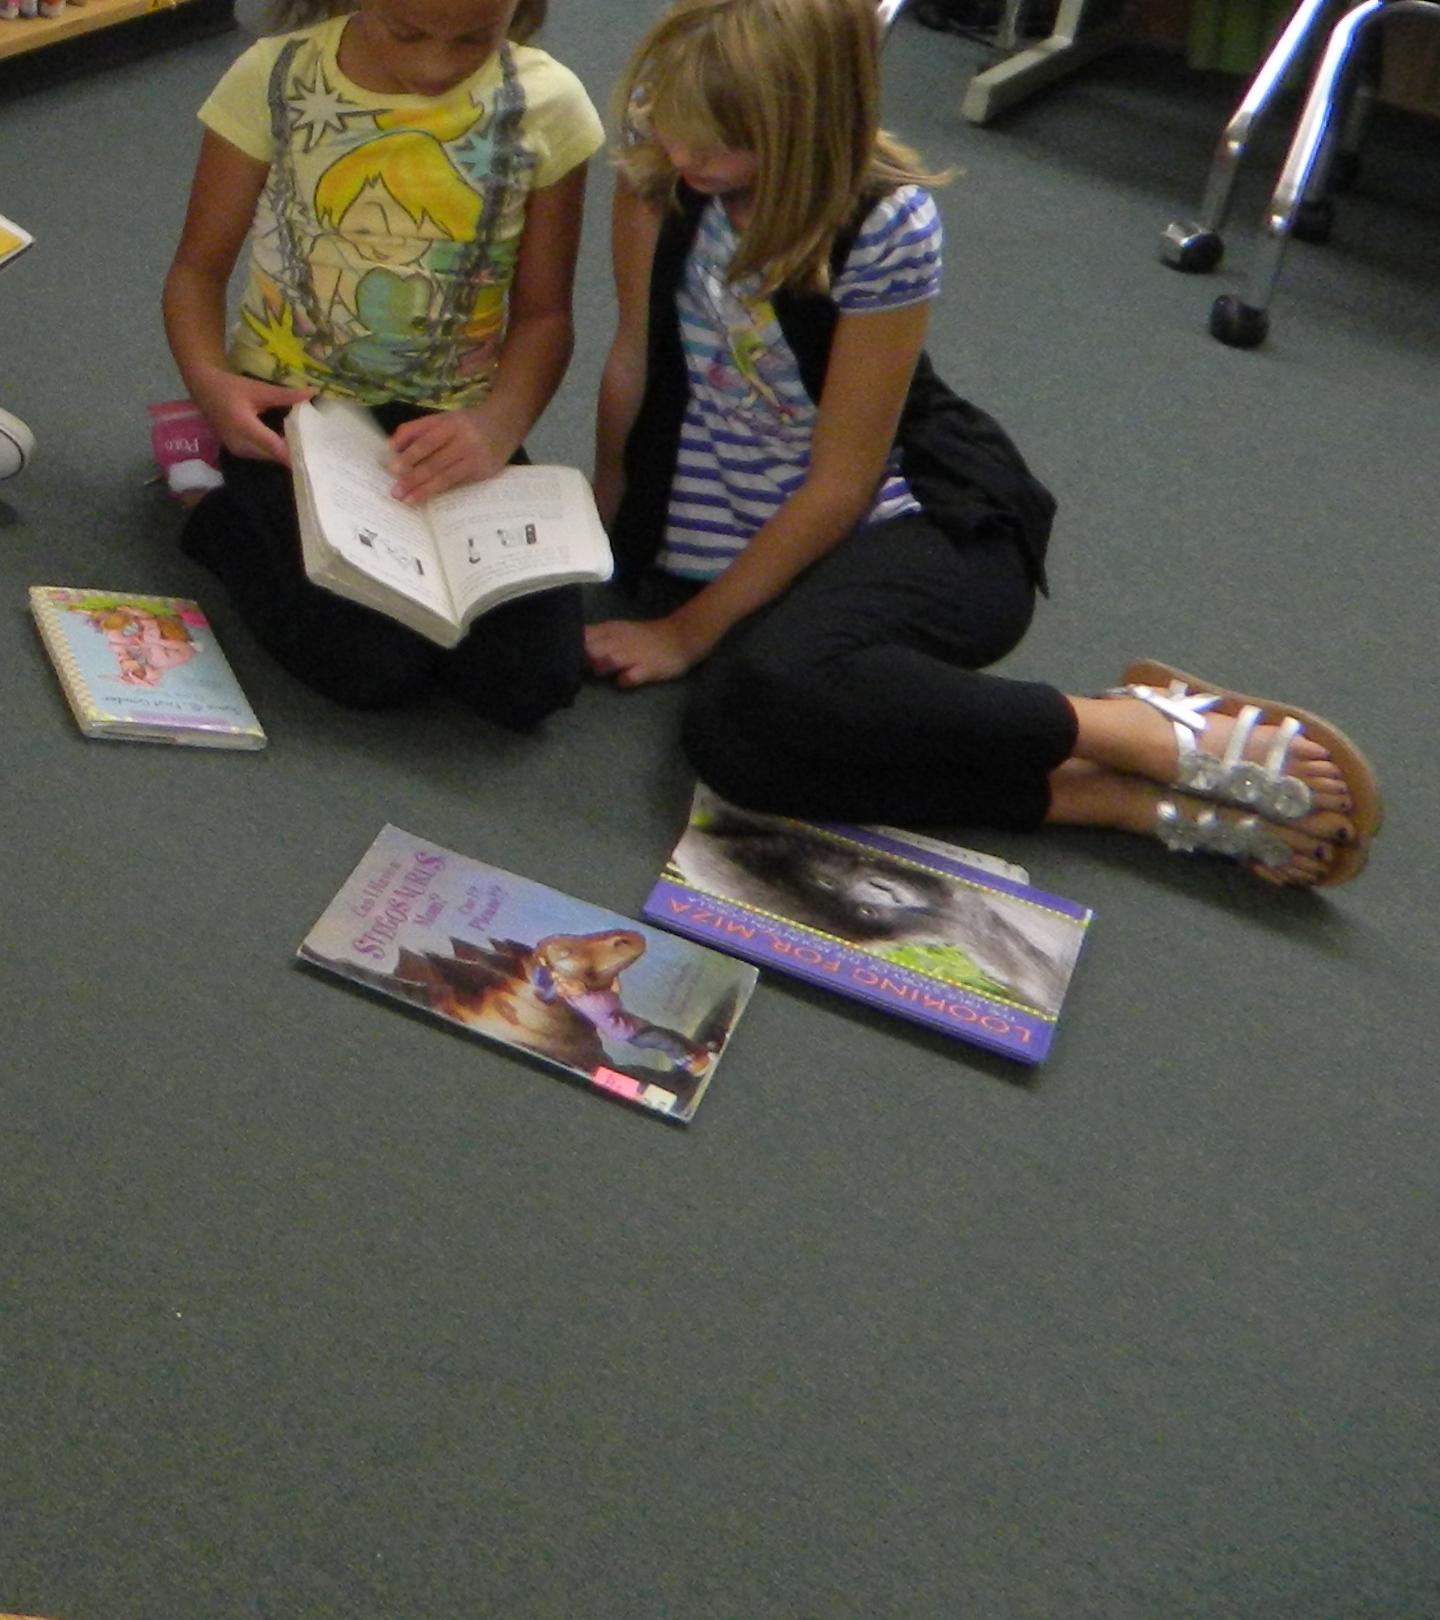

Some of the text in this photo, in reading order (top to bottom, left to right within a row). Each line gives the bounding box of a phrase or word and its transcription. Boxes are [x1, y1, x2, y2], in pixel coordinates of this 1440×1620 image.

[671, 898, 1031, 1044] LOOKING FOR MIZA
